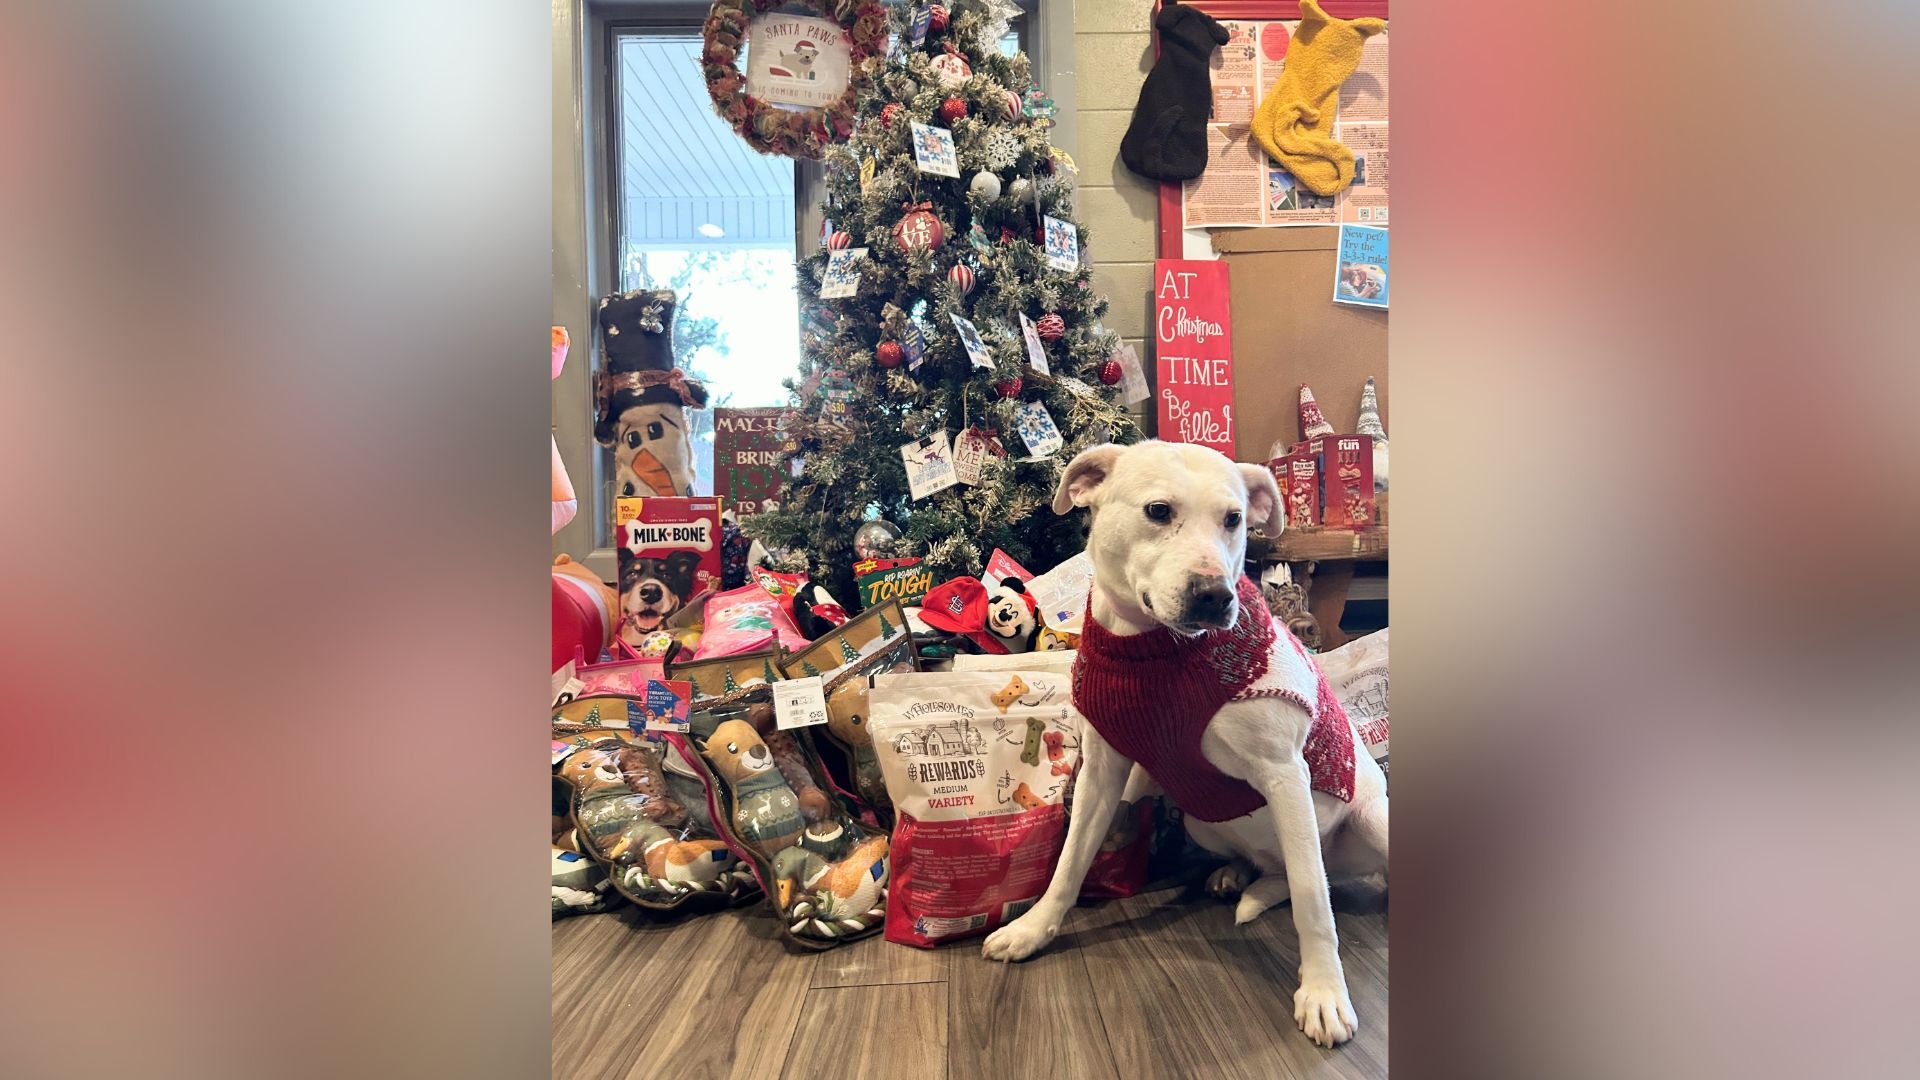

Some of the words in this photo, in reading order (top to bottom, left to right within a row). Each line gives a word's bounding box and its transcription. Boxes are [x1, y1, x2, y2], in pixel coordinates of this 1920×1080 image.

[765, 23, 800, 39] SANTA
[806, 25, 838, 46] PAWS
[758, 86, 766, 95] IS
[770, 87, 799, 97] COMING
[804, 90, 812, 98] TO
[818, 92, 838, 101] TOWN
[1344, 228, 1363, 239] New
[1366, 231, 1384, 241] pet?
[1344, 239, 1359, 250] Try
[1361, 241, 1375, 251] the
[1343, 250, 1365, 261] 3-3-3
[1367, 255, 1388, 265] rule!
[1158, 269, 1198, 300] AT
[1158, 305, 1224, 344] Christmas
[1160, 356, 1229, 387] TIME
[1162, 388, 1191, 421] Be
[717, 417, 761, 433] MAY
[1179, 404, 1232, 444] filled
[1338, 439, 1360, 451] fun
[736, 450, 777, 466] BRIN
[956, 469, 978, 481] OME
[620, 505, 630, 513] 10
[737, 501, 756, 513] TO
[634, 528, 668, 545] MILK
[673, 526, 706, 543] BONE
[884, 572, 896, 583] RIP
[868, 570, 934, 605] TOUGH
[902, 701, 975, 721] WHOLESOMES
[920, 759, 977, 783] REWARDS
[933, 784, 969, 795] MEDIUM
[928, 795, 975, 809] VARIETY
